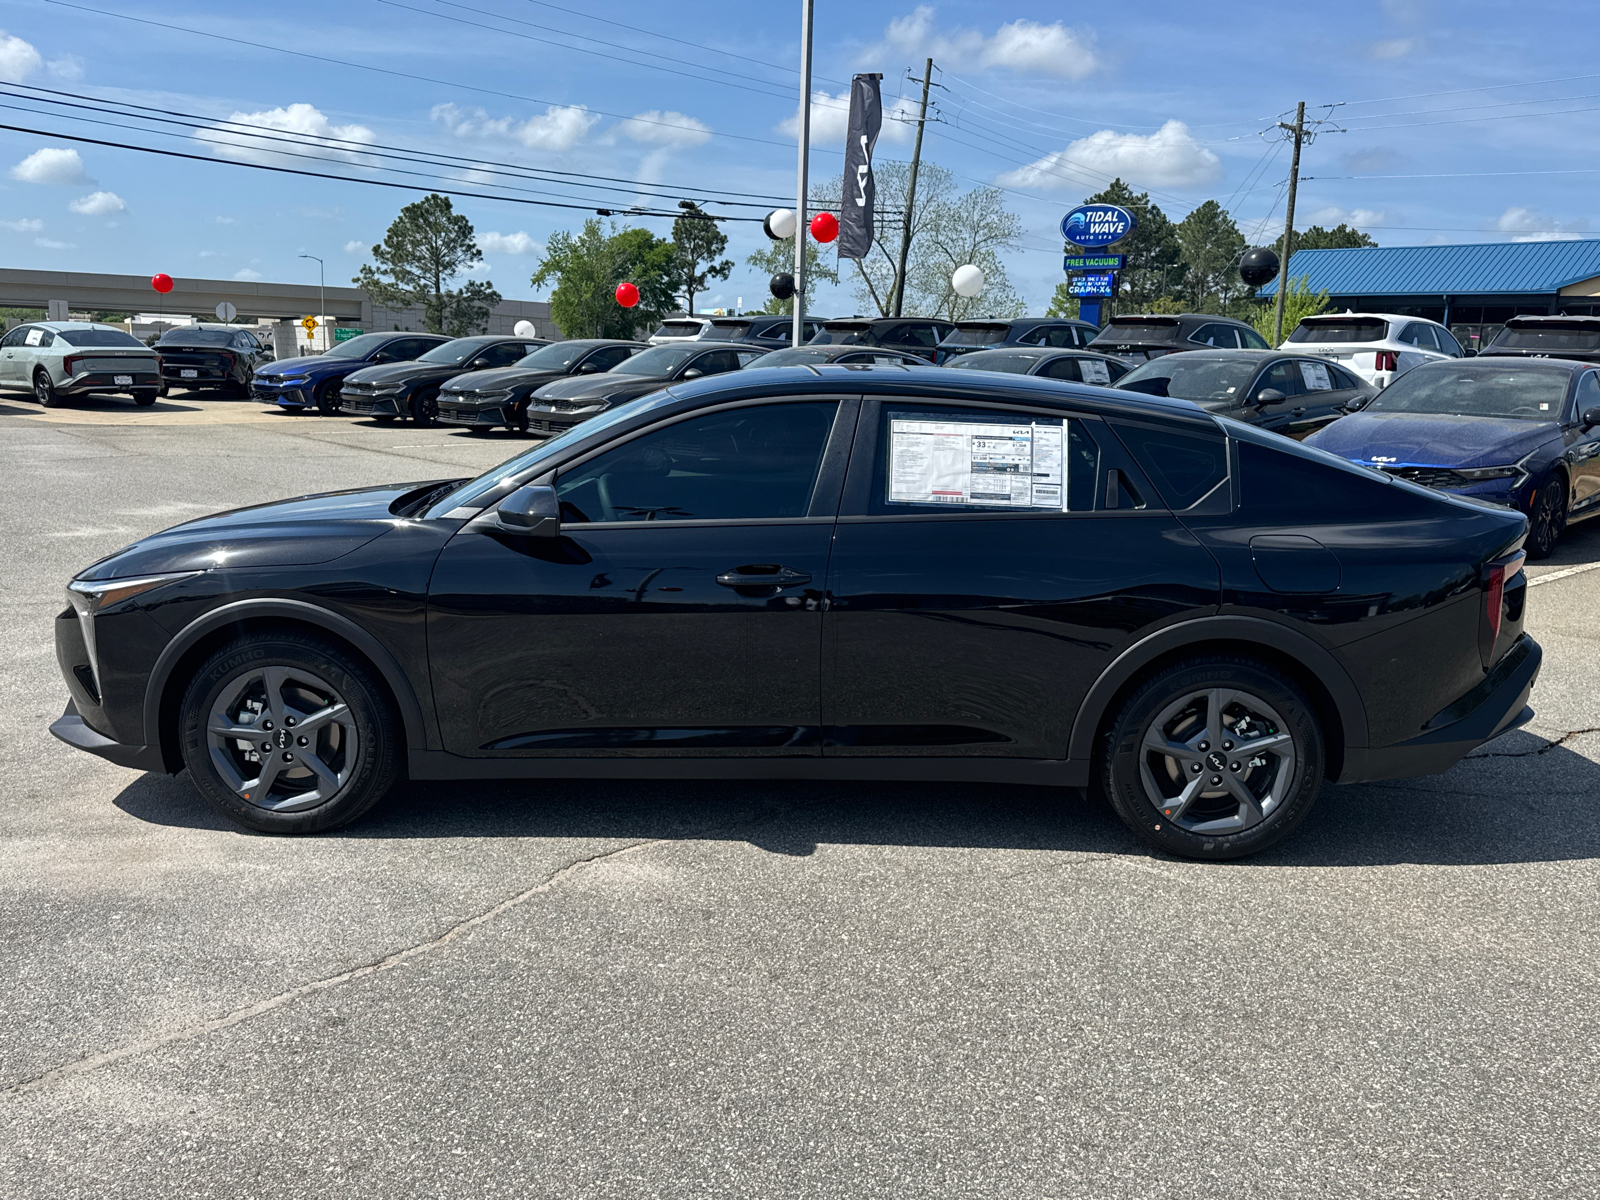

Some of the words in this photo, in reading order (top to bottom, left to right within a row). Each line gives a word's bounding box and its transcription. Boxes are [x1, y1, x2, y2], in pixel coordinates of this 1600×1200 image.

[1086, 211, 1119, 222] TIDAL
[1090, 222, 1125, 234] WAVE
[1066, 259, 1084, 267] FREE
[1085, 257, 1119, 266] VACUUMS
[1068, 286, 1111, 294] GRAPH-X4
[209, 649, 265, 682] KUMHO
[1169, 671, 1232, 691] KUMHO
[361, 722, 376, 781] SOLUS
[1287, 765, 1314, 820] SOLUS
